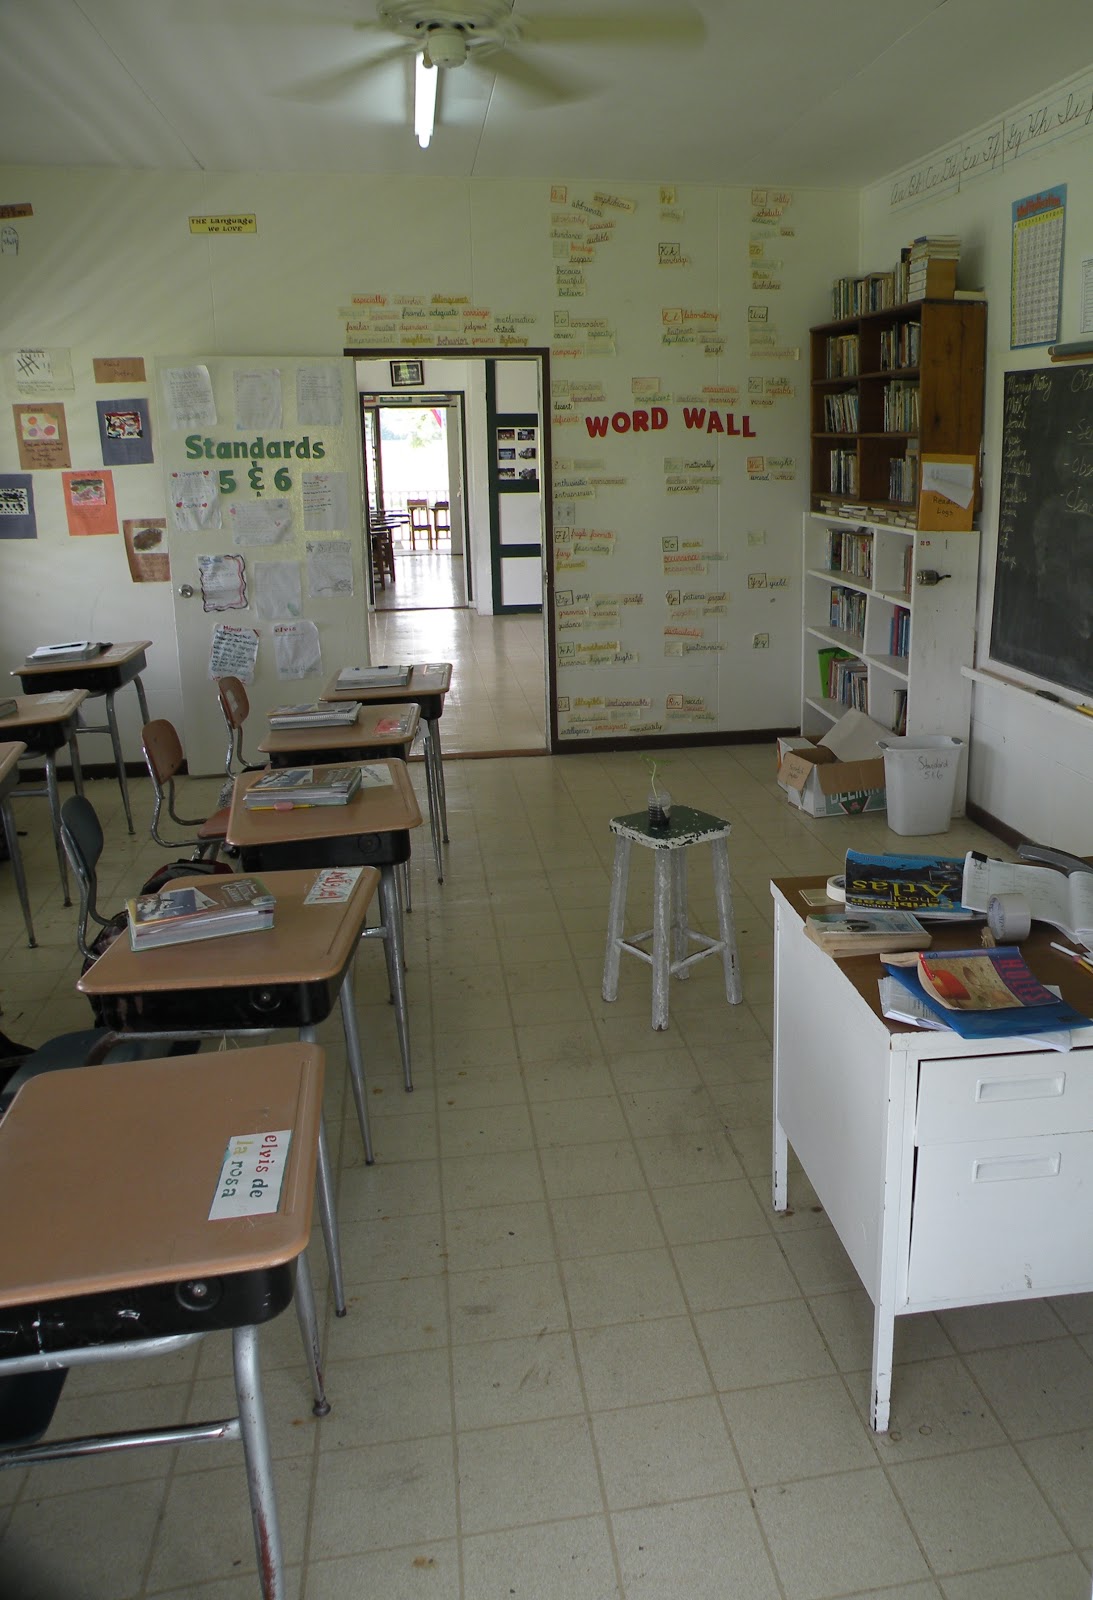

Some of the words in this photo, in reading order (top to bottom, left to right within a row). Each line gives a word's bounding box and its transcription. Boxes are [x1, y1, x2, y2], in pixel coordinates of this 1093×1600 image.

[210, 217, 254, 226] Language
[585, 407, 669, 438] WORD
[683, 407, 757, 438] WALL
[185, 434, 326, 460] Standards
[219, 470, 237, 494] 5
[274, 467, 292, 492] 6
[852, 880, 952, 898] Atlas
[233, 1140, 255, 1156] la
[256, 1135, 278, 1173] elvis
[221, 1160, 243, 1198] rosa
[249, 1178, 269, 1198] de
